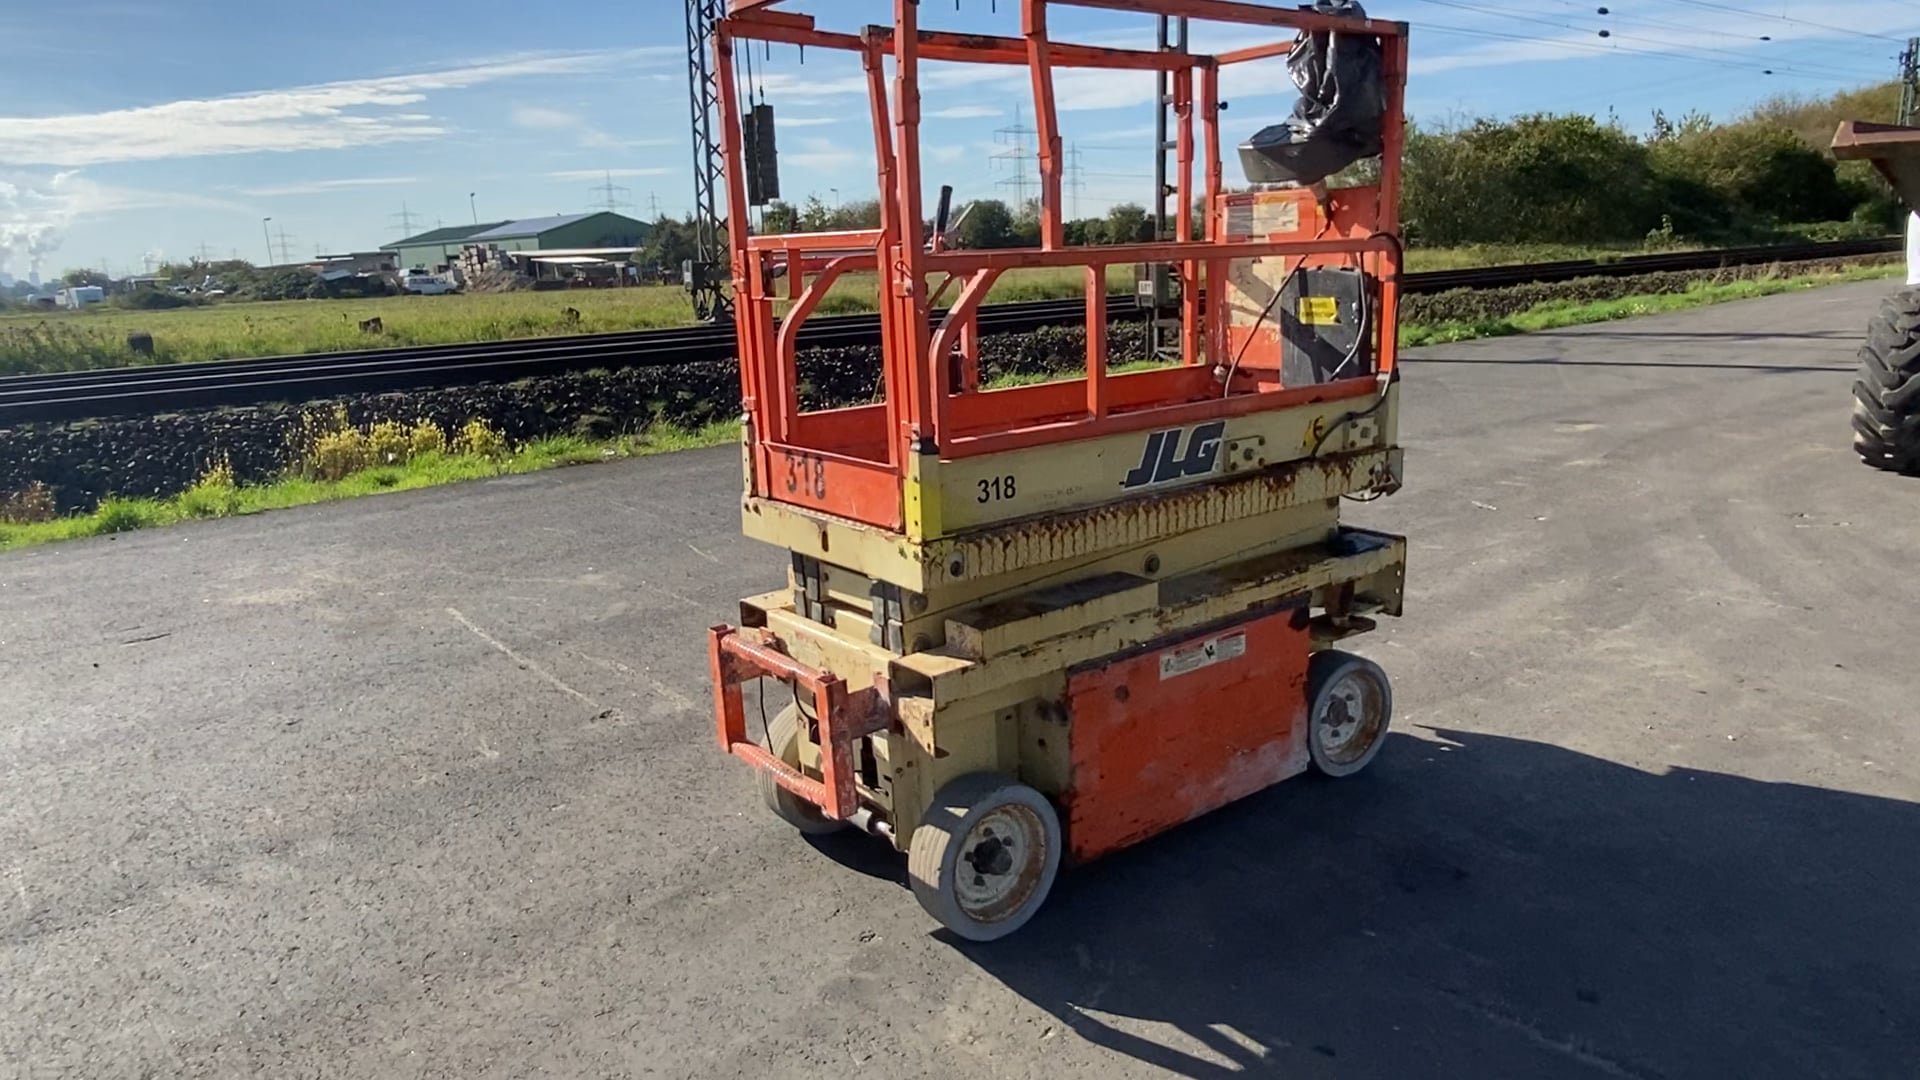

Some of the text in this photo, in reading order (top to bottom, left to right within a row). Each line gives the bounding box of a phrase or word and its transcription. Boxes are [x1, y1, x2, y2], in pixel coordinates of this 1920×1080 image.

[785, 450, 826, 500] 318
[1124, 421, 1226, 489] JLG
[977, 475, 1016, 504] 318
